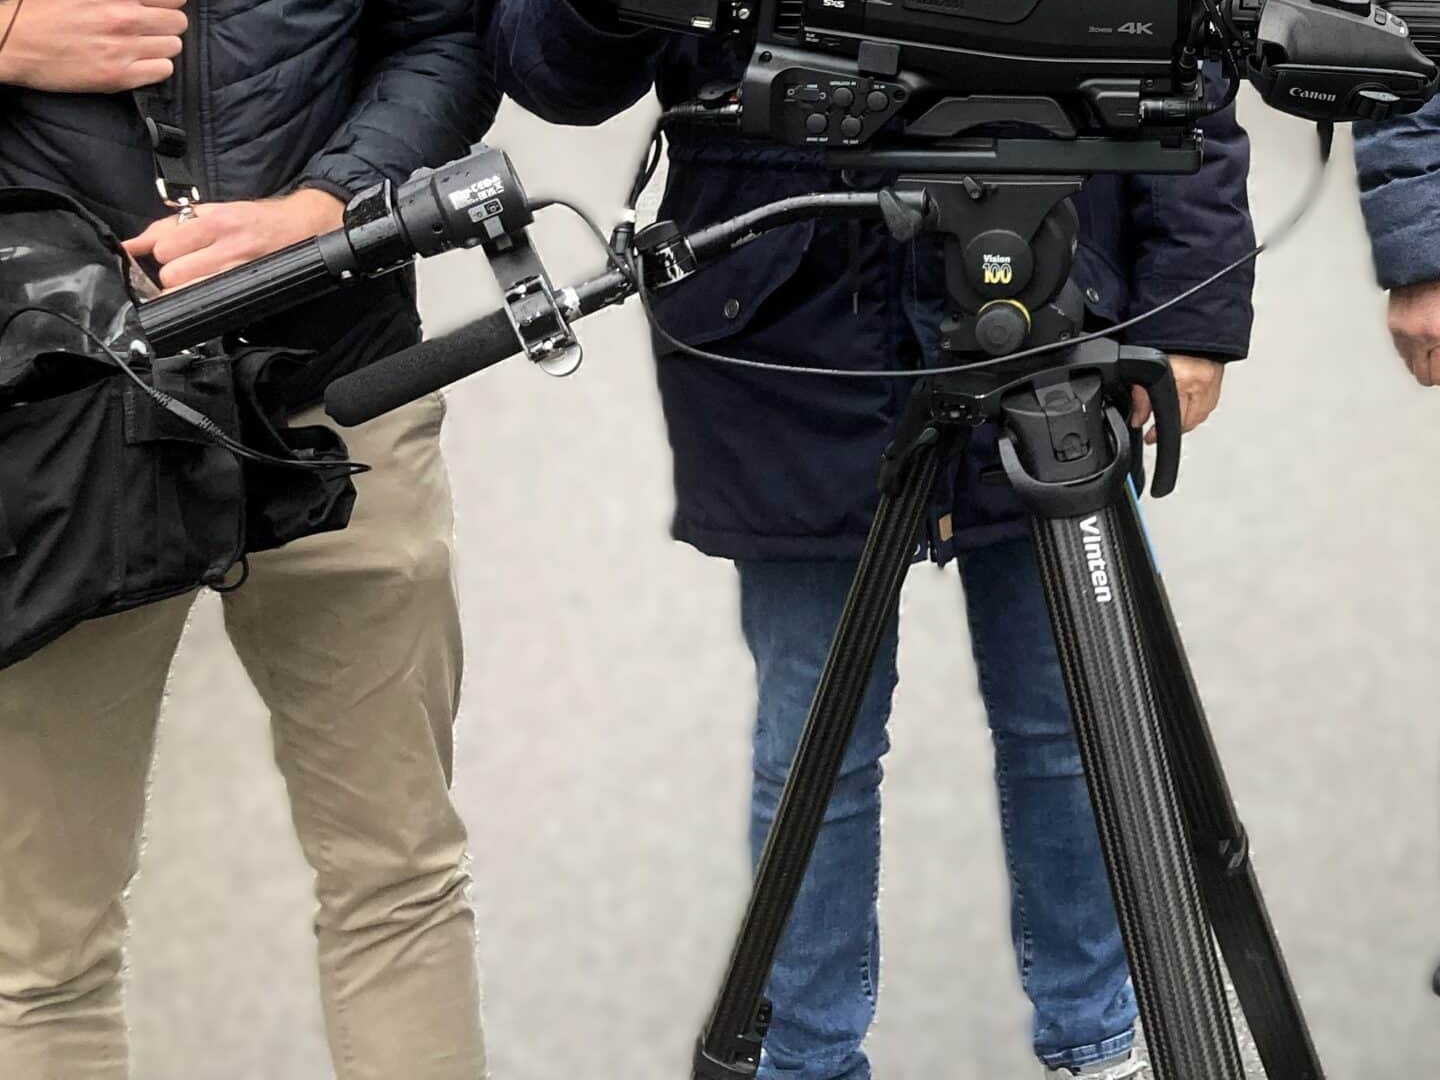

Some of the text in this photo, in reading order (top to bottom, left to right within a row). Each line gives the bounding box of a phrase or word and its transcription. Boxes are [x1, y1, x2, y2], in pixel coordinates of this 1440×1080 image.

[1117, 22, 1153, 35] 4K
[1289, 87, 1337, 102] Canon
[982, 262, 1012, 284] 100
